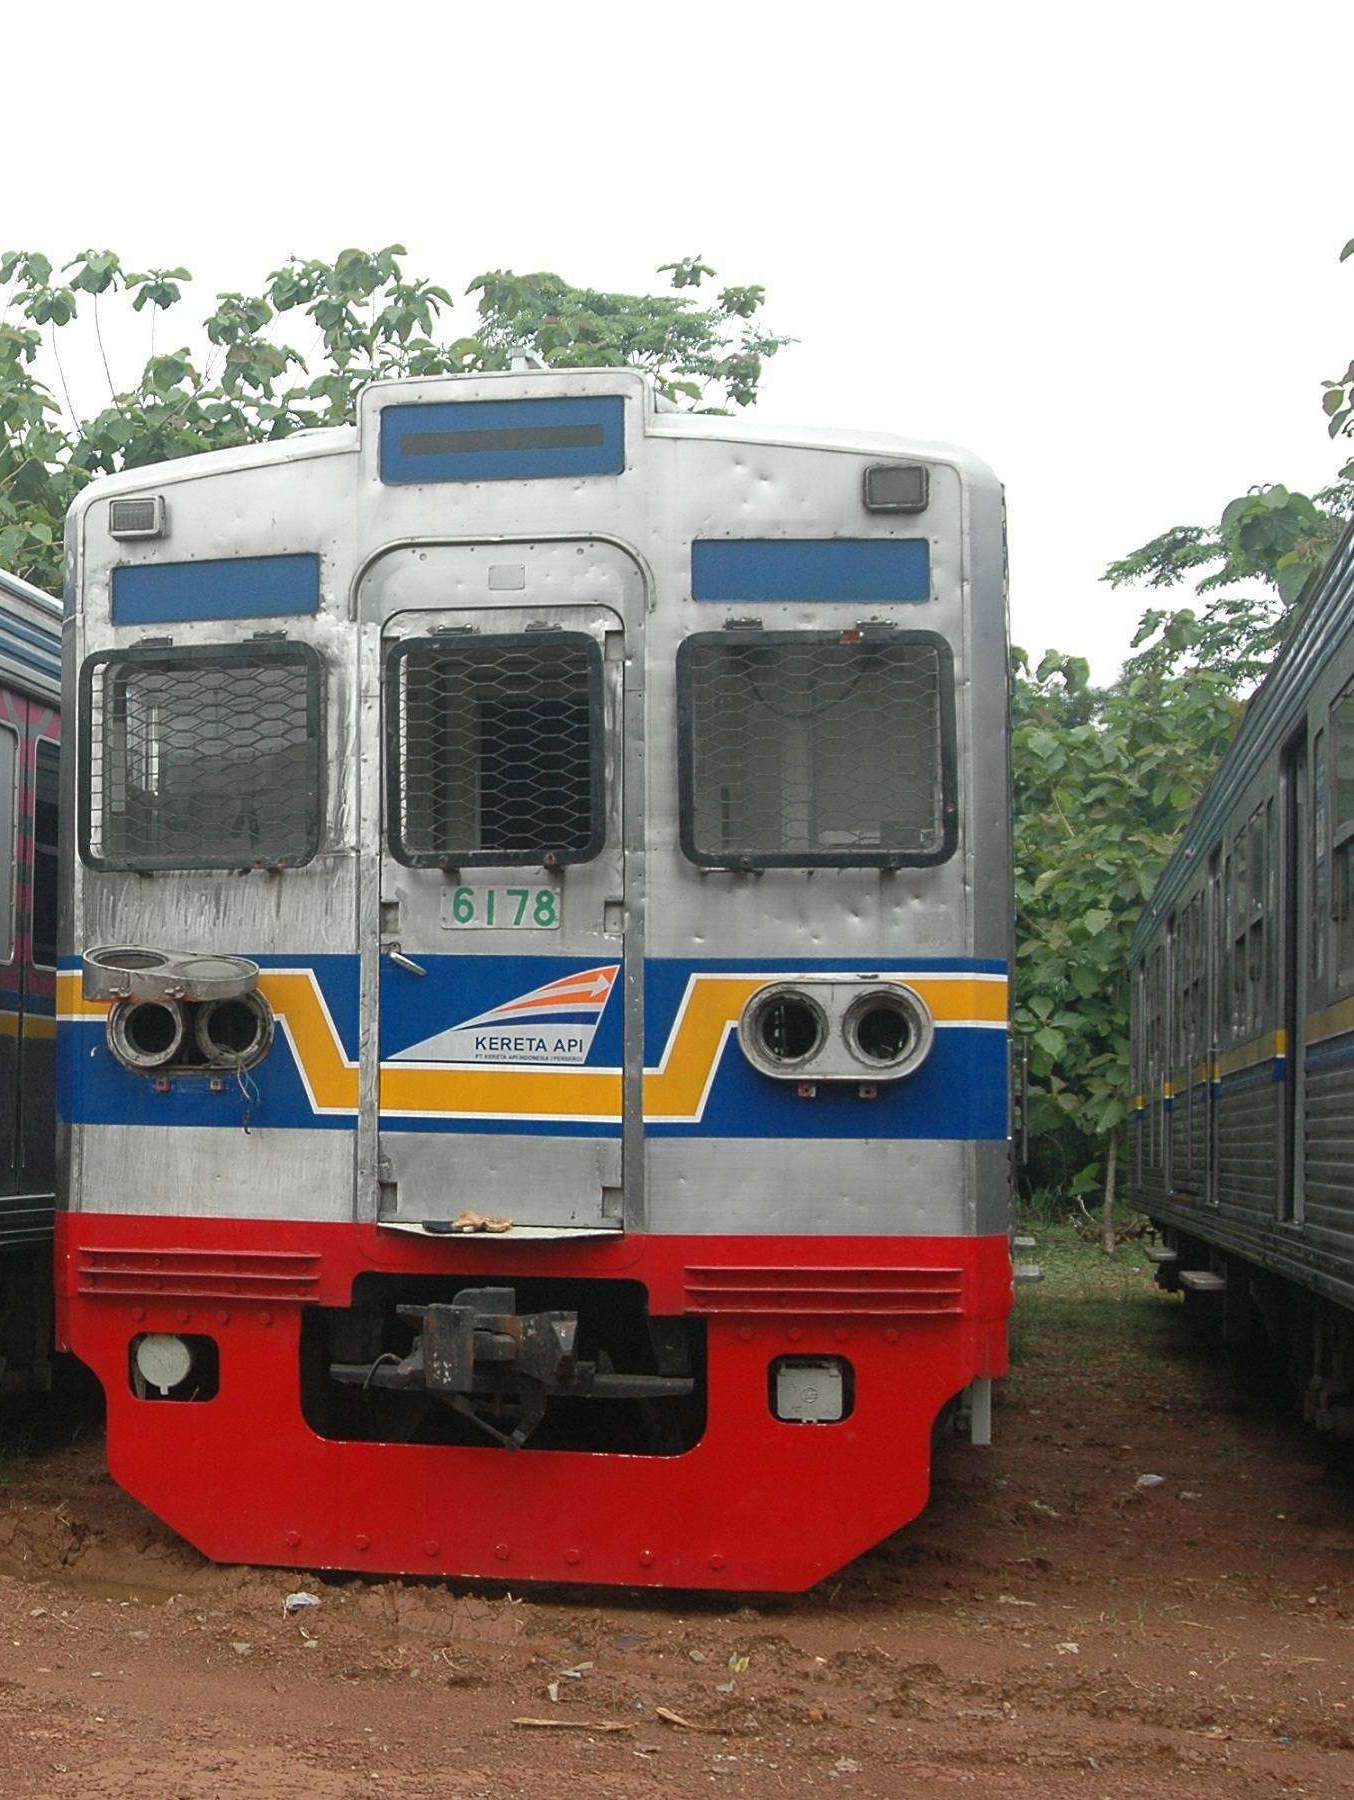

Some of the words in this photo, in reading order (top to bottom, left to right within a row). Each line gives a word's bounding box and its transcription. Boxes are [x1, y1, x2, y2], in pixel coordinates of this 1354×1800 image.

[453, 886, 556, 927] 6178
[475, 1036, 547, 1052] KERETA
[553, 1037, 583, 1053] API
